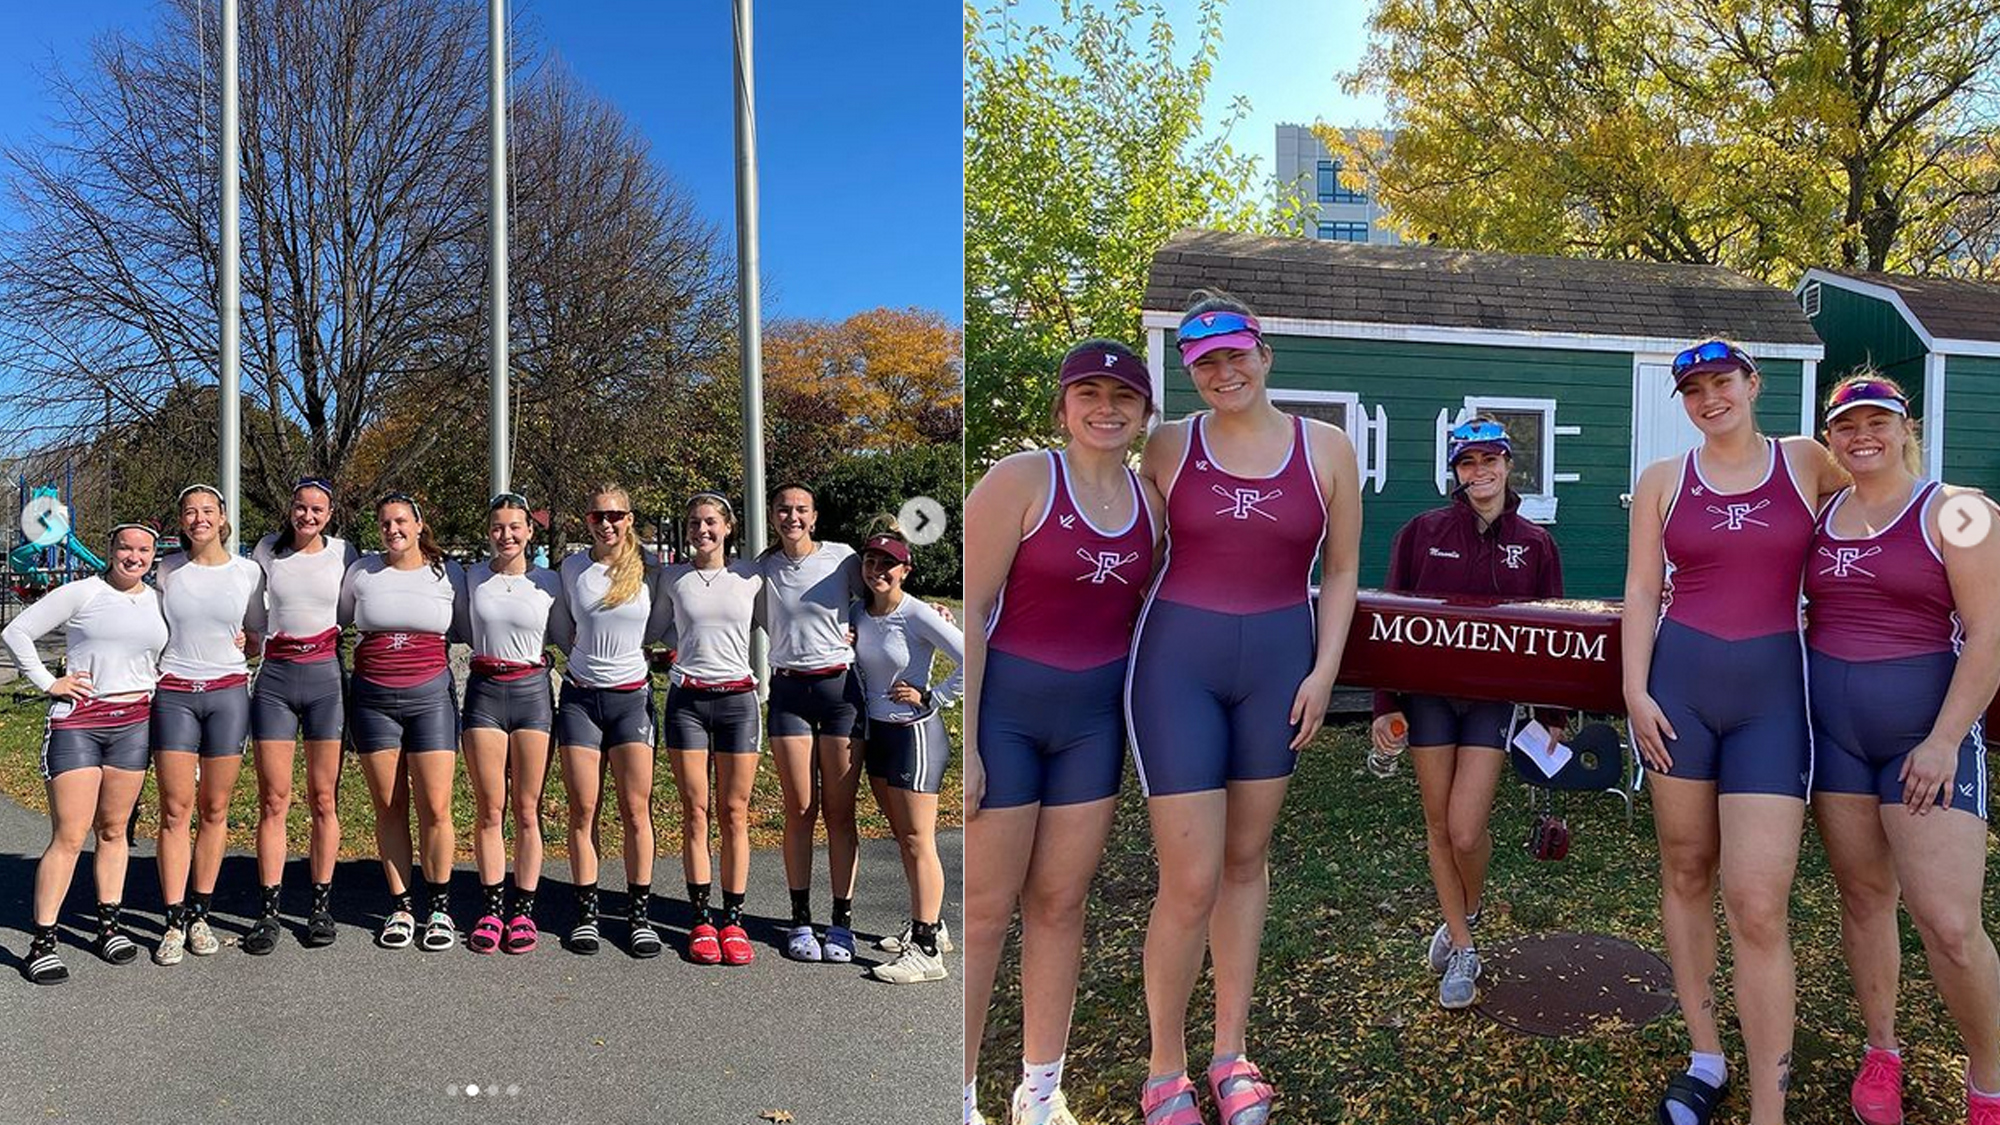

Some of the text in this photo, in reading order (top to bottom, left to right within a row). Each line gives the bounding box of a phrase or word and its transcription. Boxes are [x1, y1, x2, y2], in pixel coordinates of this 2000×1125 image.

[1104, 354, 1118, 367] F
[1235, 488, 1260, 519] F
[1728, 503, 1750, 530] F
[1092, 551, 1119, 583] F
[1506, 545, 1523, 565] F
[1835, 548, 1859, 576] F
[1369, 613, 1607, 662] MOMENTUM
